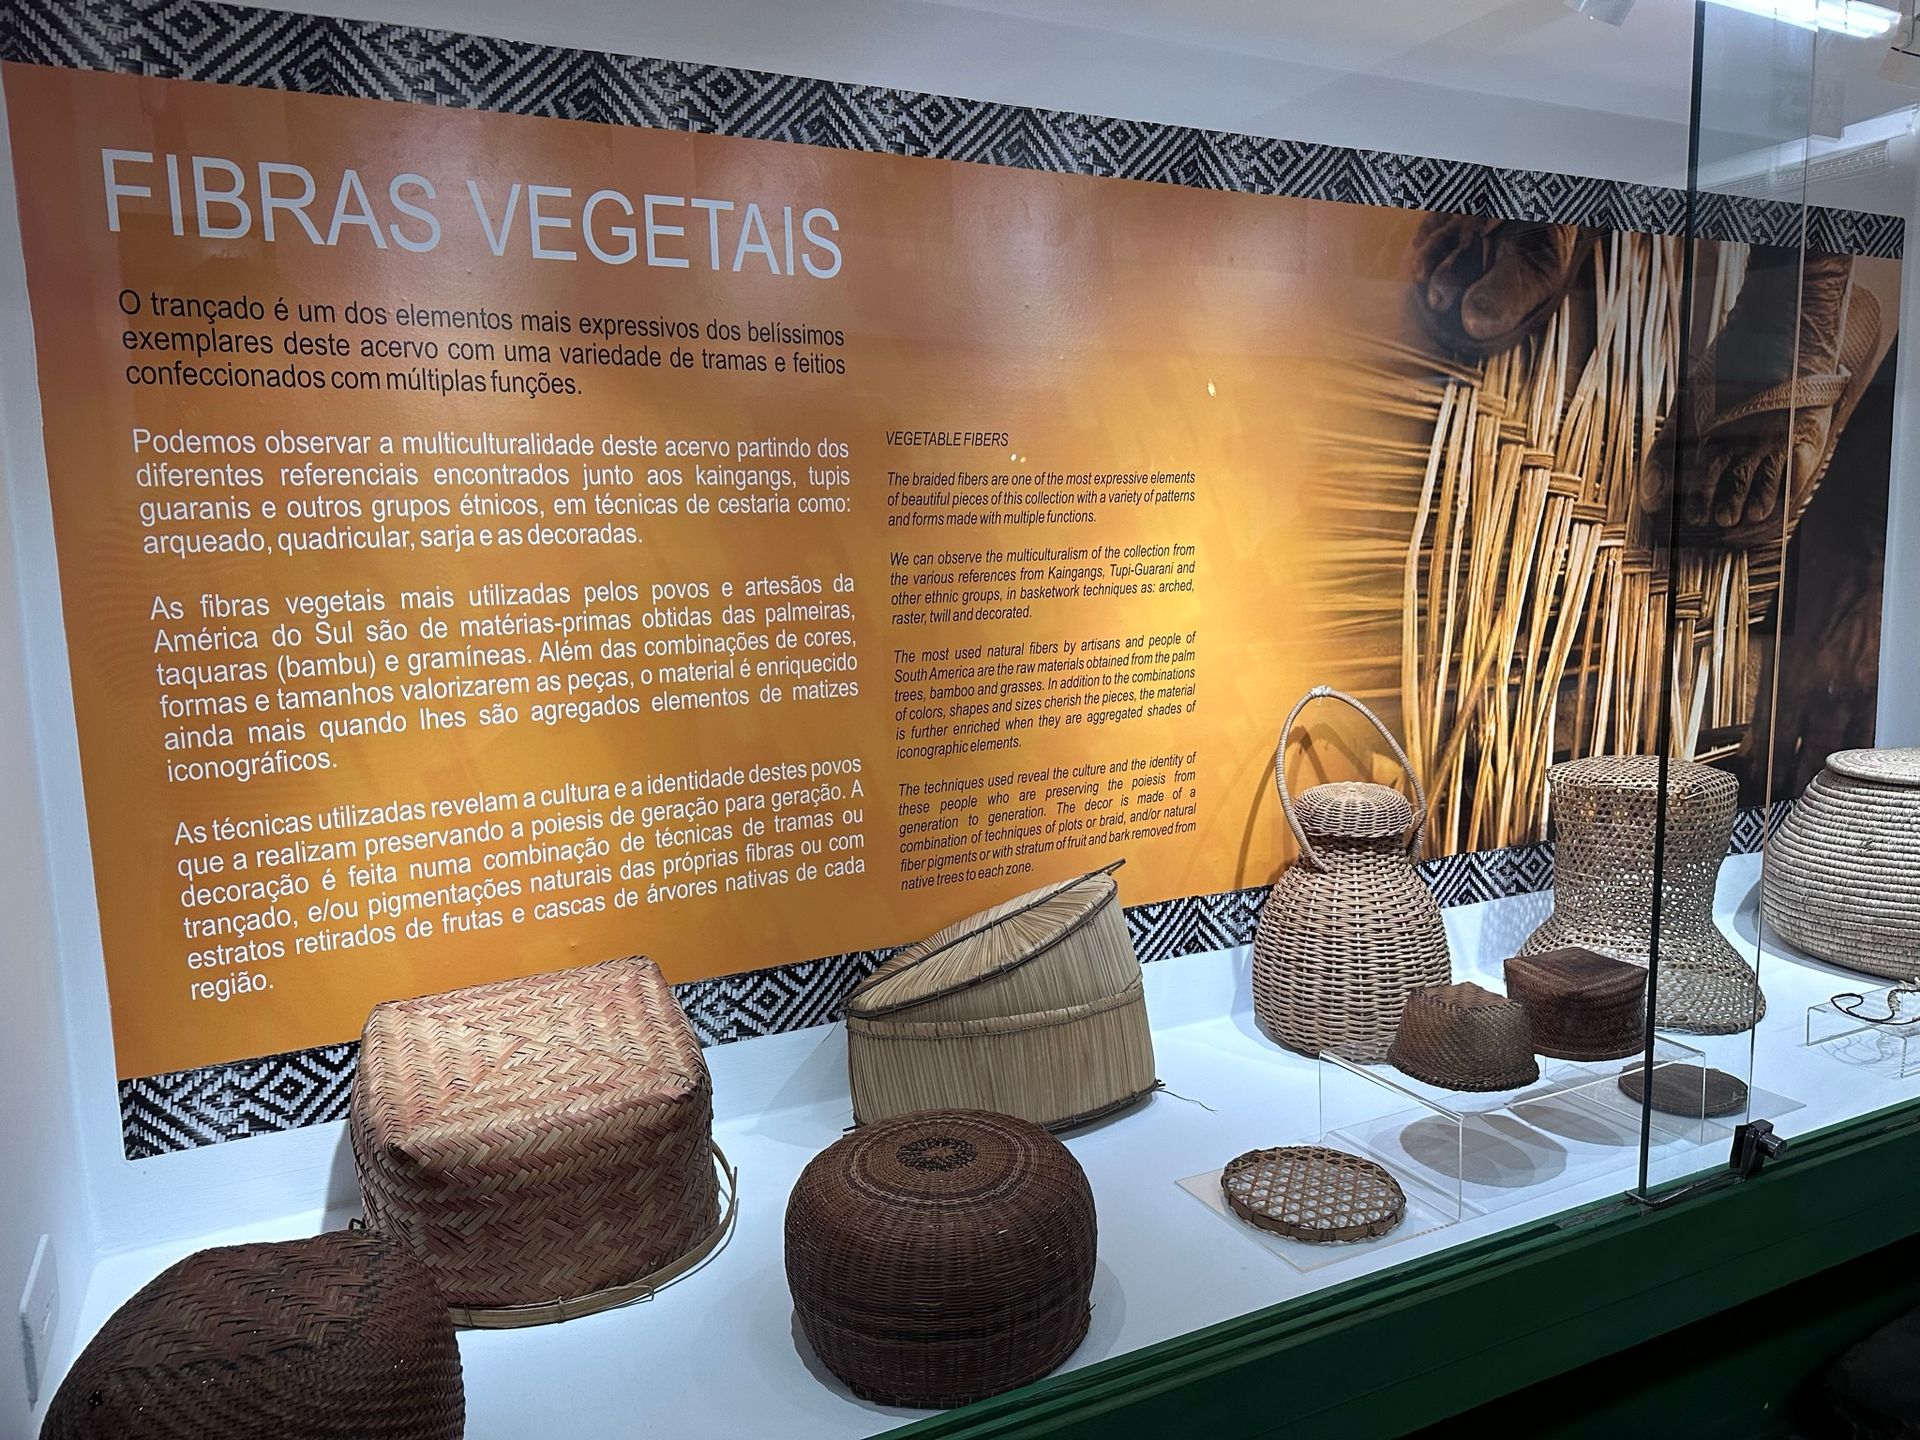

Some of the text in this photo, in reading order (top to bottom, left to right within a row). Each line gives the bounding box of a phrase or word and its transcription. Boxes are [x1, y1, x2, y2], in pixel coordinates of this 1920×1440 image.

[101, 148, 843, 280] FIBRAS VEGETAIS
[118, 289, 845, 347] O trançado é um dos elementos mais expressivos dos belíssimos
[126, 360, 582, 400] confeccionados com múltiplas funções.
[132, 428, 849, 463] Podemos observar a multiculturalidade deste acervo partindo dos
[886, 431, 1009, 447] VEGETABLE FIBERS
[136, 462, 851, 491] diferentes referenciais encontrados junto aos kaingangs, tupis
[887, 470, 1196, 488] The braided fibers are one of the most expressive elements
[887, 509, 1097, 527] and forms made with multiple functions.
[143, 522, 643, 560] arqueado, quadricular, sarja e as decoradas.
[890, 560, 1196, 586] the various references from Kaingangs, Tupi-Guarani and
[891, 578, 1195, 606] other ethnic groups, in basketwork techniques as: arched,
[153, 600, 855, 654] América do Sul são de matérias-primas obtidas das palmeiras,
[891, 604, 1032, 625] raster, twill and decorated.
[155, 628, 856, 690] taquaras (bambu) e gramíneas. Além das combinações de cores,
[894, 667, 1196, 703] trees, bamboo and grasses. In addition to the combinations
[896, 735, 1022, 760] iconographic elements.
[167, 749, 337, 783] iconográficos.
[174, 758, 862, 846] As técnicas utilizadas revelam a cultura e a identidade destes povos
[898, 770, 1196, 816] these people who are preserving the poiesis from
[899, 802, 1197, 854] combination of techniques of plots or braid, and/or natural
[182, 833, 865, 939] trançado, e/ou pigmentações naturais das próprias fibras ou com
[901, 862, 1034, 891] native trees to each zone.
[190, 970, 274, 1003] região.
